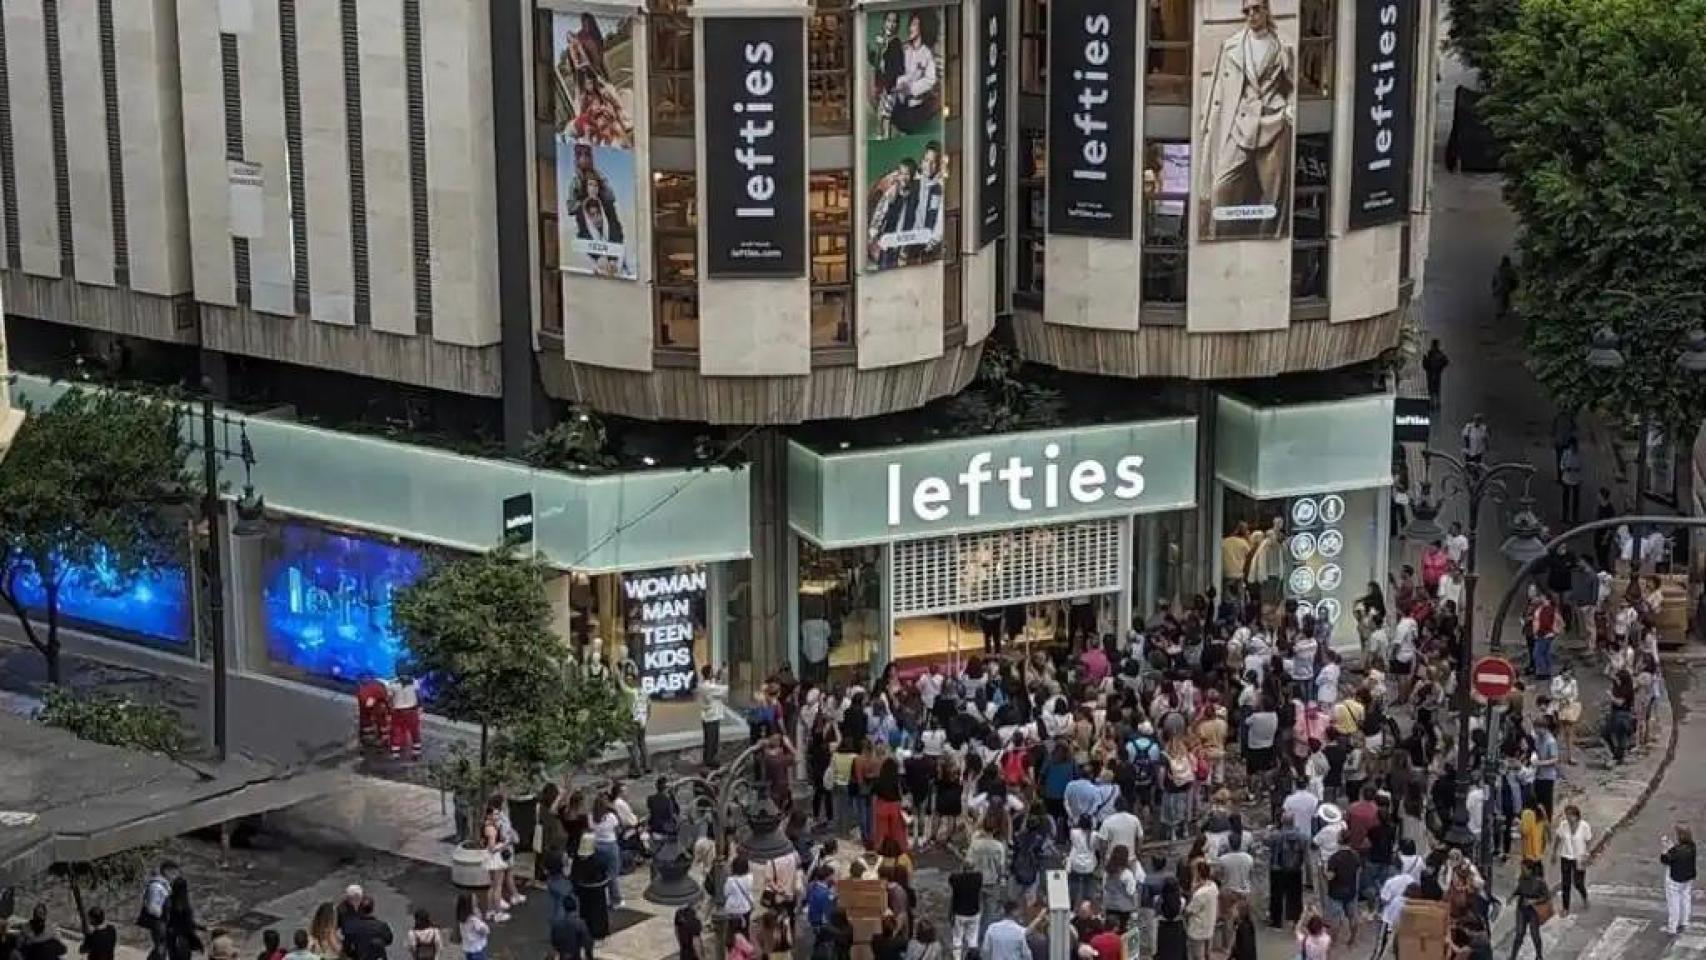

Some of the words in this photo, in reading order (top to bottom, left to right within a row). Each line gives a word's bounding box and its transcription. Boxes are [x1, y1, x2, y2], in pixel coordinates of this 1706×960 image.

[986, 15, 998, 186] lefties
[1072, 14, 1110, 180] lefties
[1368, 4, 1397, 171] lefties
[733, 41, 775, 217] lefties
[887, 443, 1145, 526] lefties
[625, 571, 707, 600] WOMAN
[642, 598, 689, 621] MAN
[641, 621, 694, 646] TEEN
[644, 647, 690, 669] KIDS
[641, 670, 694, 694] BABY
